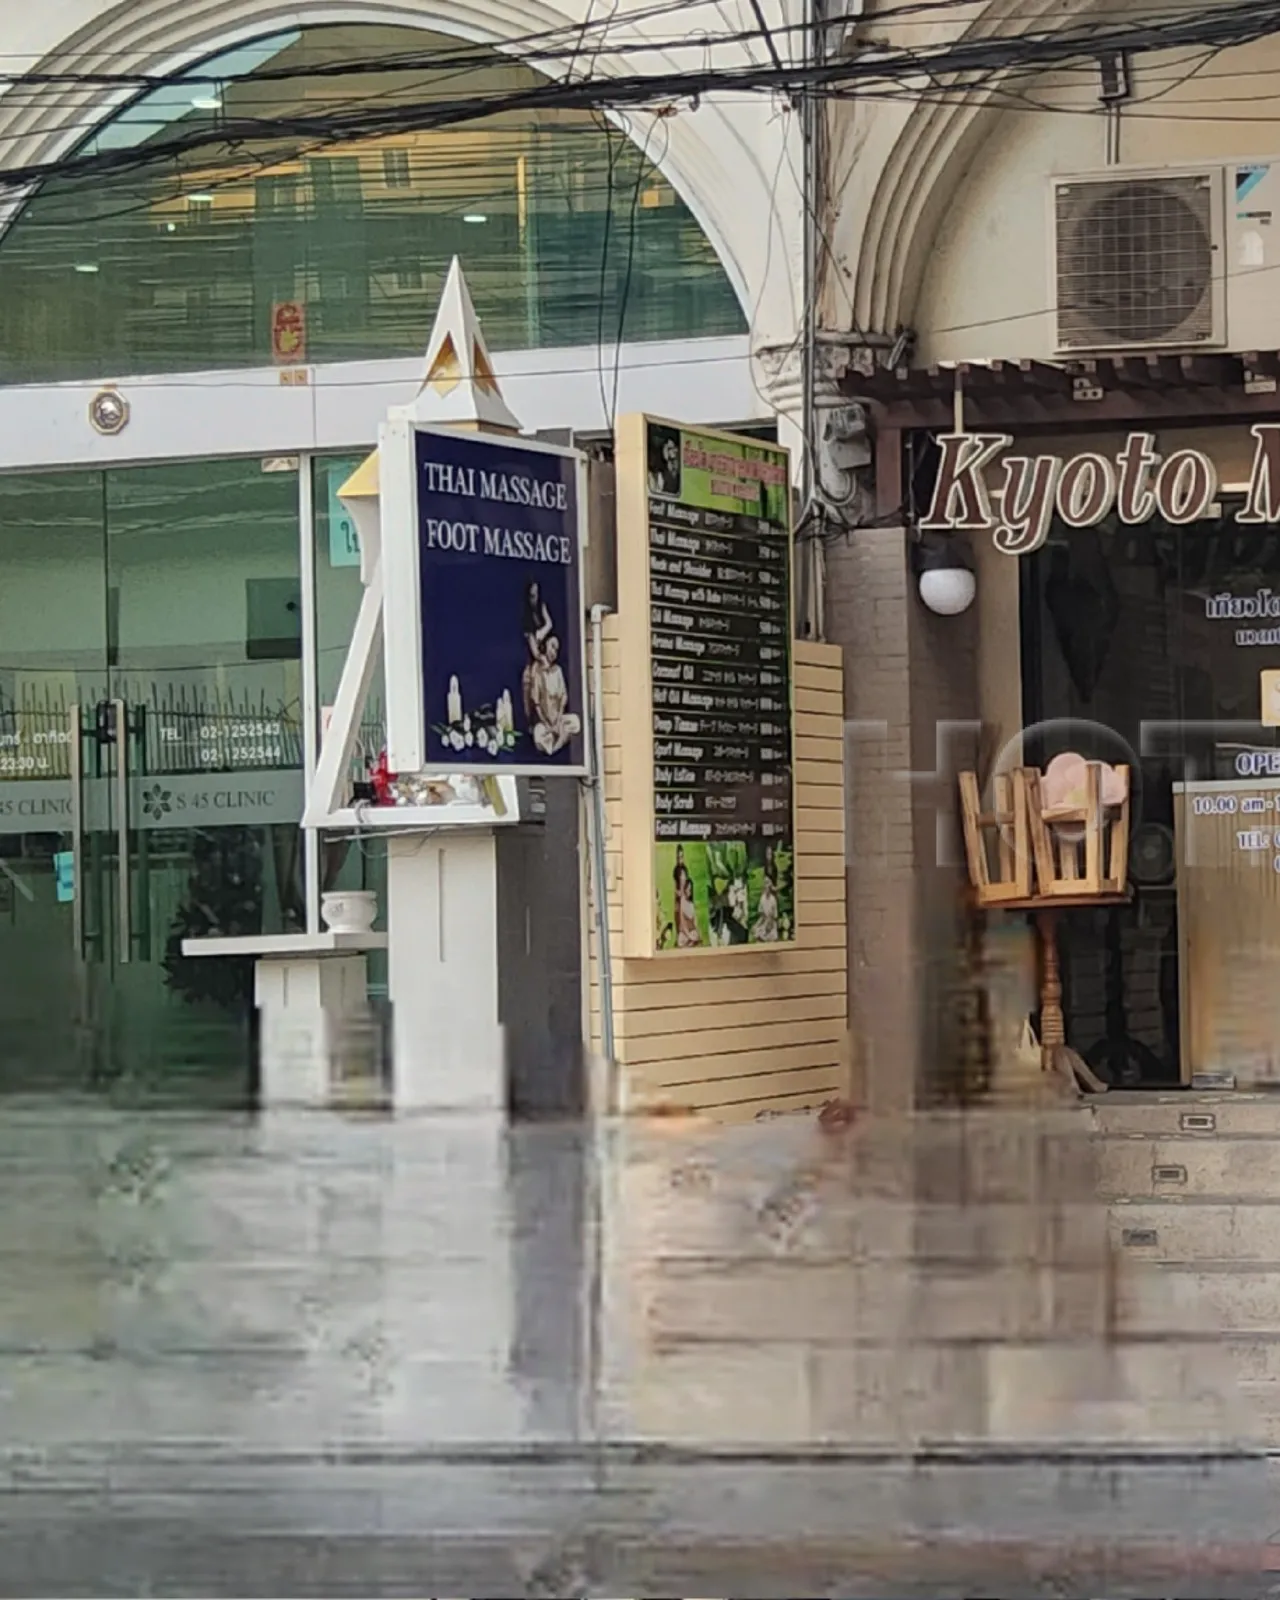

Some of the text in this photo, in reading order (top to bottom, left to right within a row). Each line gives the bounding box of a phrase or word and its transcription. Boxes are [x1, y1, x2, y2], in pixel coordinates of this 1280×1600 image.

[424, 462, 568, 511] THAI MASSAGE
[920, 431, 1217, 555] Kyoto
[426, 518, 572, 564] FOOT MASSAGE
[200, 723, 280, 738] 02-1252543
[201, 746, 281, 761] 02-1252544
[213, 790, 276, 808] CLINIC
[1193, 795, 1237, 815] 10.00
